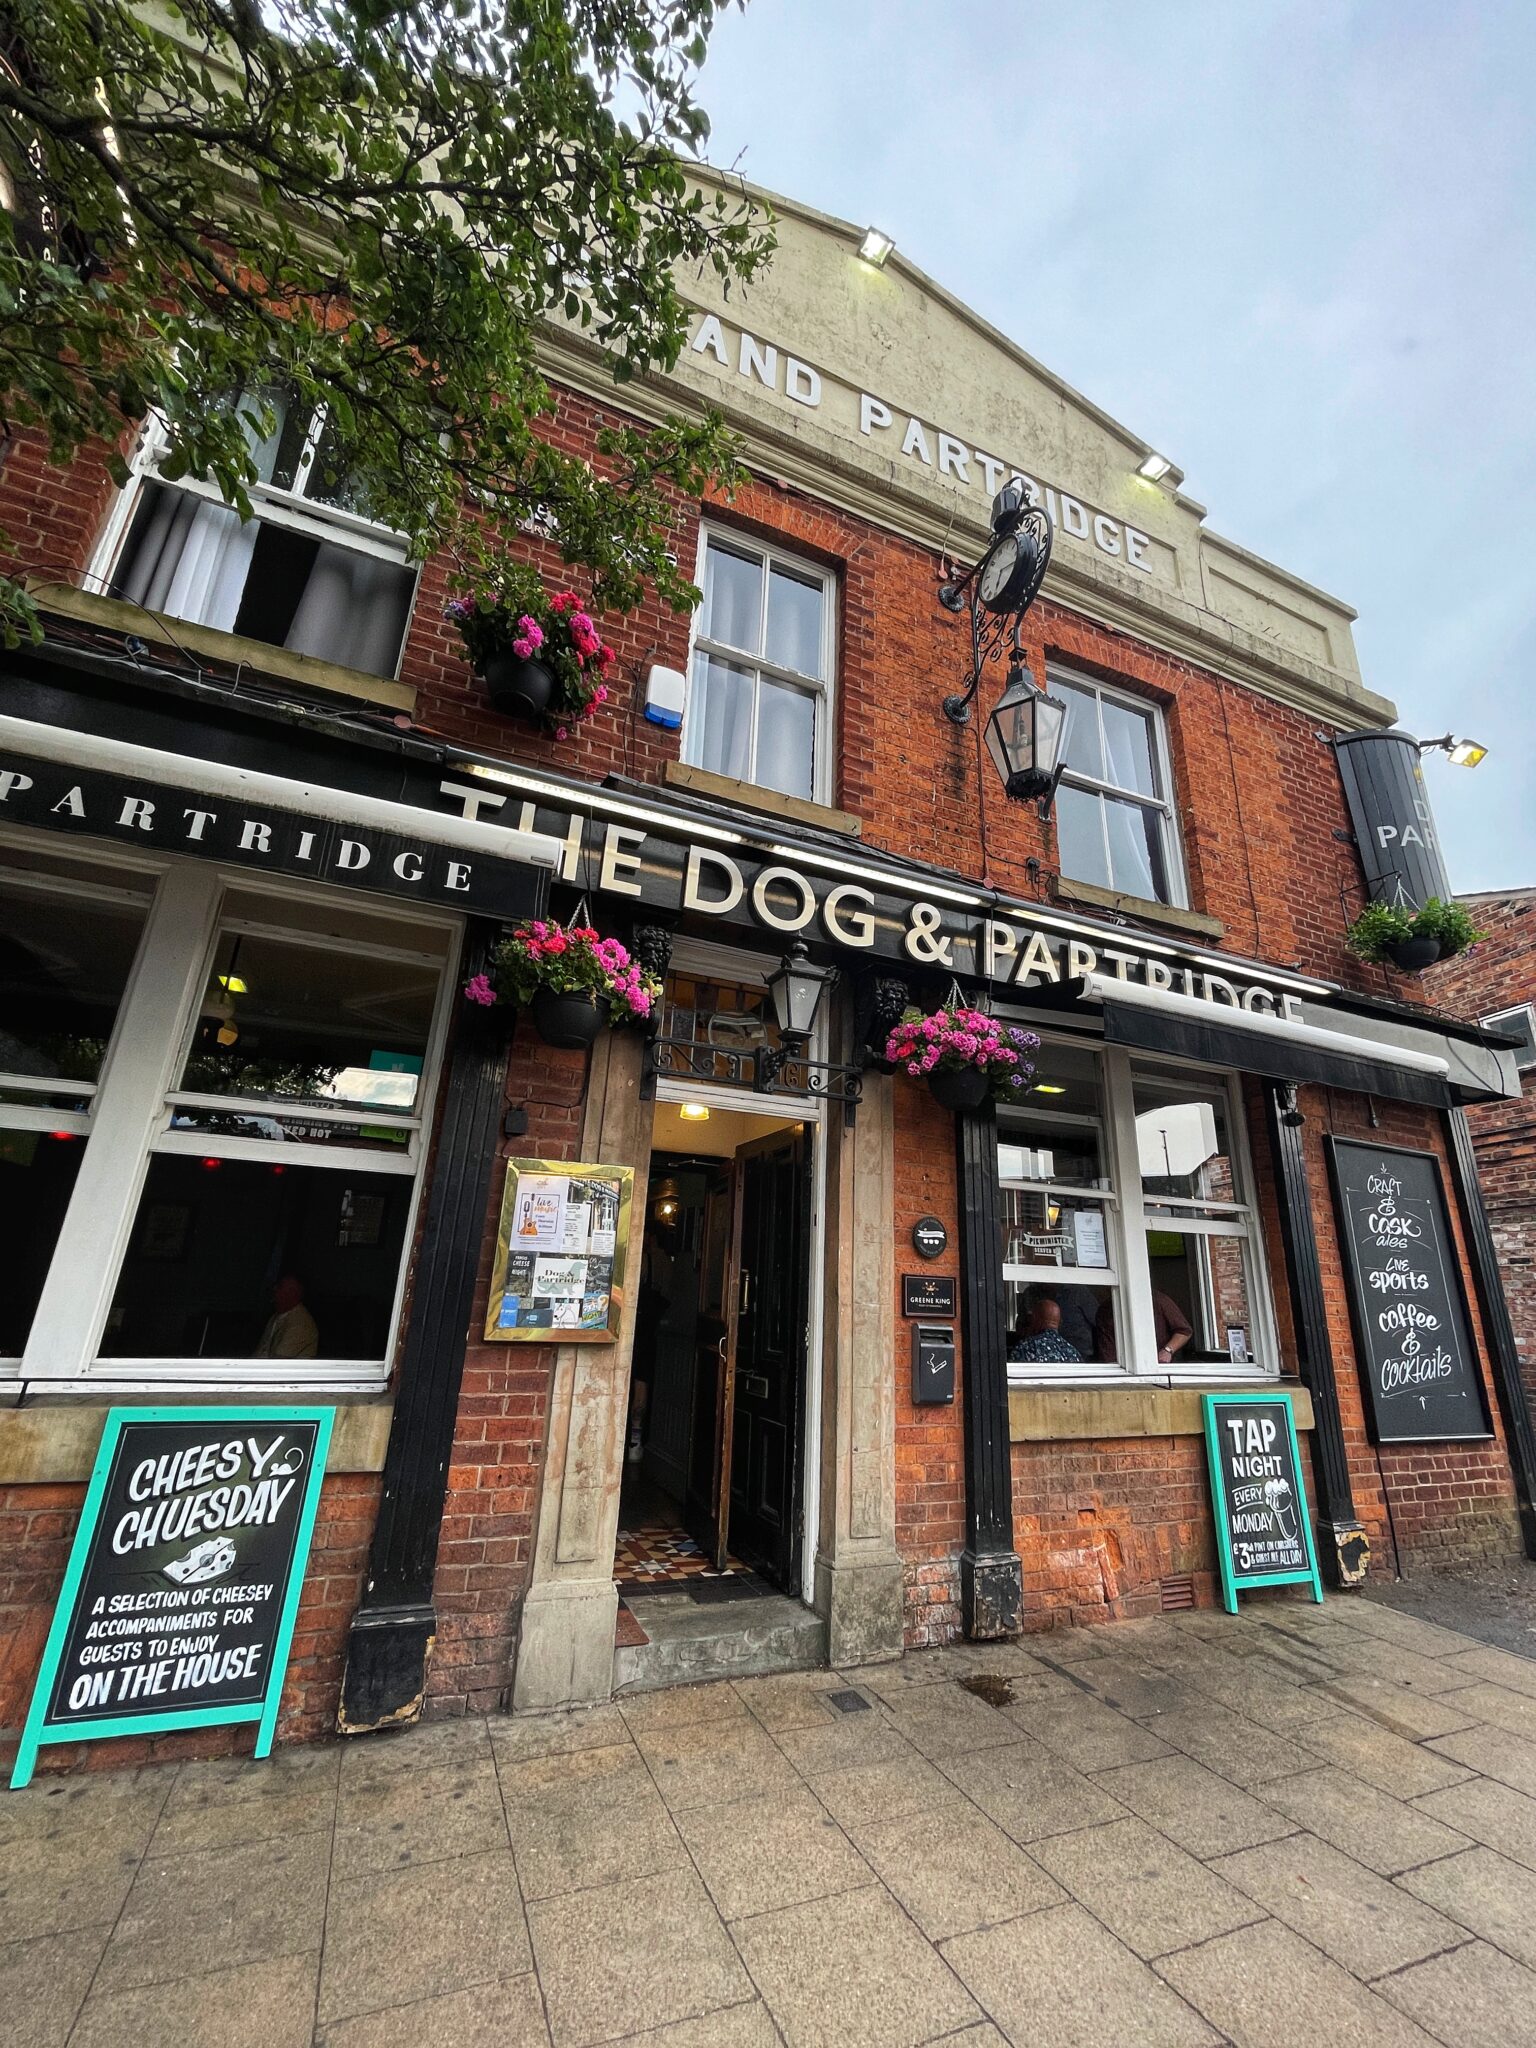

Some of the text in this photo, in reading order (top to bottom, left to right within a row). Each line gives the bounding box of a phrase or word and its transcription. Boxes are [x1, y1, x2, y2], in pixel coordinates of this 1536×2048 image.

[692, 315, 1153, 573] AND PARTRIDGE
[0, 769, 473, 892] PARTRIDGE
[683, 844, 876, 947] DOG
[904, 902, 953, 967] &
[536, 1276, 585, 1284] Partridge
[545, 1269, 565, 1278] Dog
[910, 1296, 934, 1304] GREENE
[1227, 1419, 1276, 1454] TAP
[129, 1436, 285, 1502] CHEESY
[1232, 1456, 1282, 1478] NIGHT
[1234, 1487, 1263, 1506] EVERY
[112, 1479, 295, 1554] CHUESDAY
[1232, 1512, 1274, 1534] MONDAY
[92, 1584, 274, 1615] A SELECTION OF CHEESEY
[86, 1607, 254, 1639] ACCOMPANIMENTS FOR
[79, 1634, 219, 1666] GUESTS TO ENJOY
[69, 1643, 263, 1710] ON THE HOUSE
